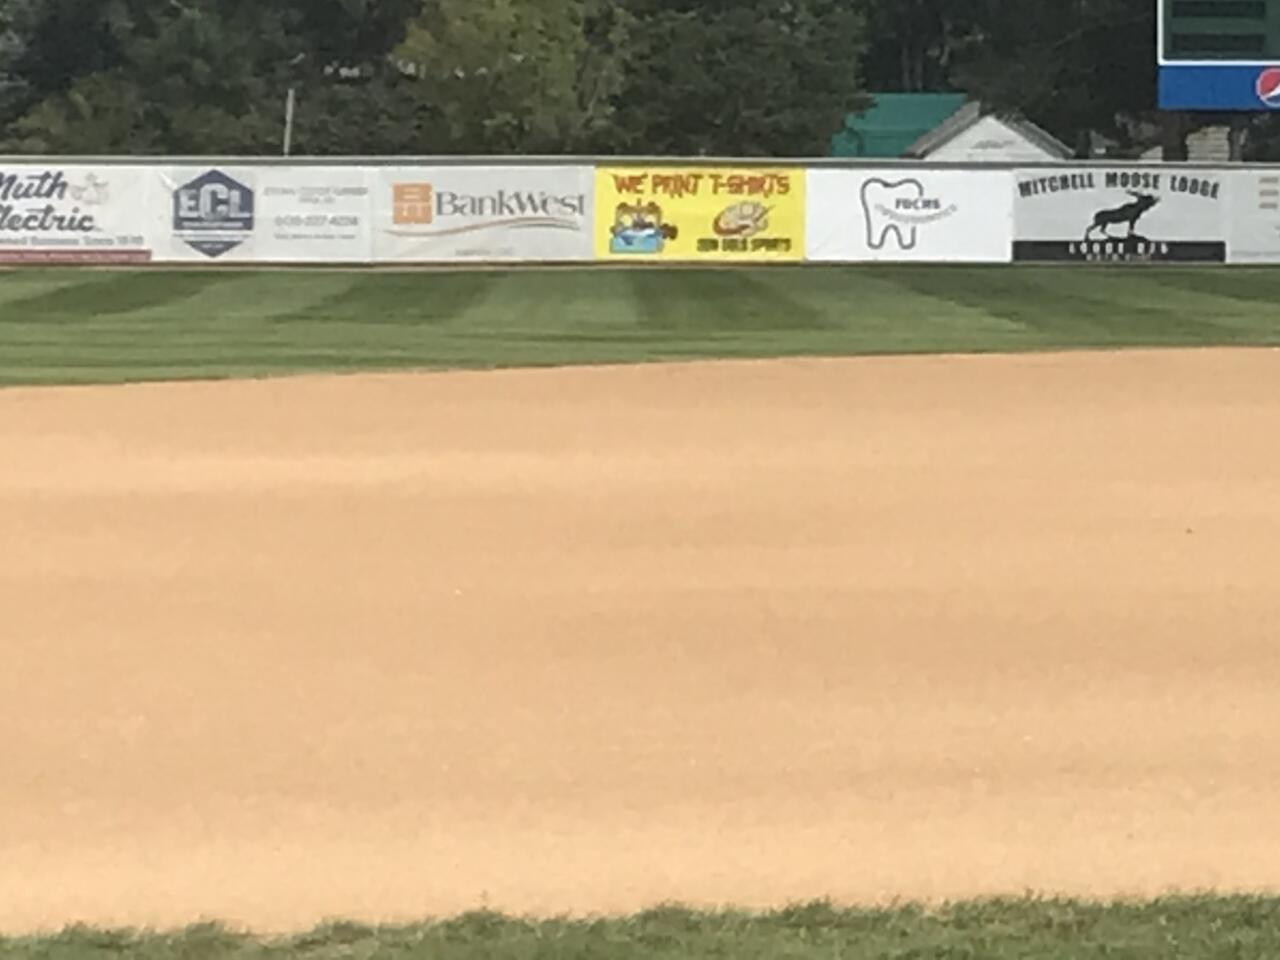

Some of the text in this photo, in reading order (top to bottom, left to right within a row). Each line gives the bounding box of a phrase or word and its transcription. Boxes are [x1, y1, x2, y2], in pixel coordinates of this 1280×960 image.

[612, 173, 790, 198] WE PRINT T-SHIRTS
[1018, 172, 1220, 199] MITCHELL MOOSE LODGE
[178, 182, 253, 221] ECL
[436, 189, 585, 217] BankWest
